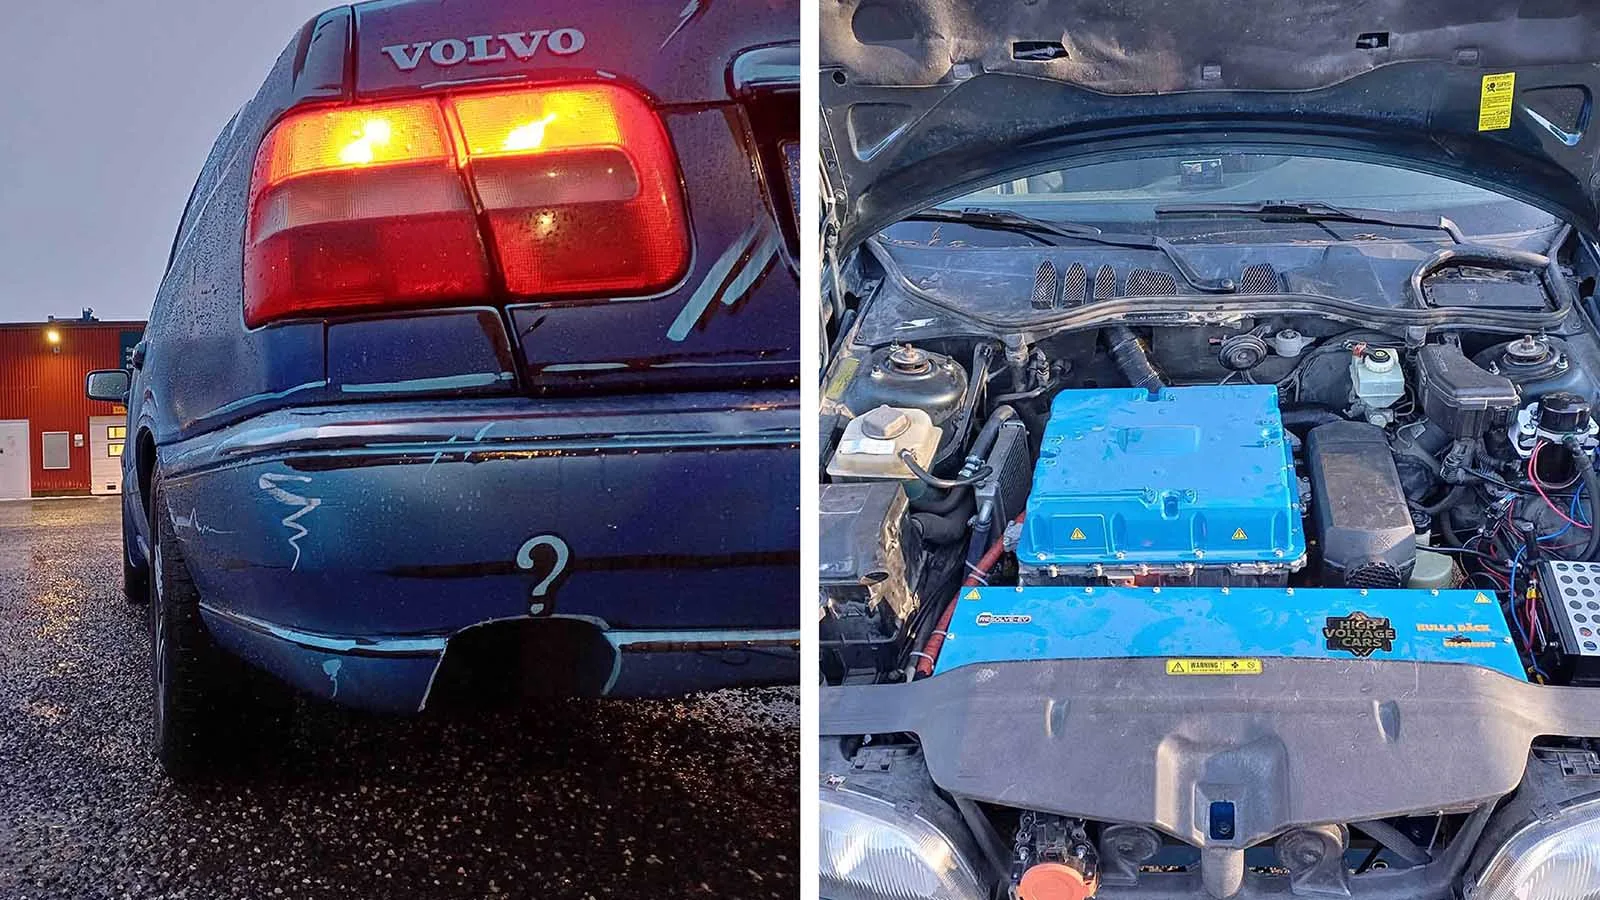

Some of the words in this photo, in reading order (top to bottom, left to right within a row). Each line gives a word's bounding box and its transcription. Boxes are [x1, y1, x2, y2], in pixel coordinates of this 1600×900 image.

[381, 27, 586, 71] VOLVO
[516, 534, 569, 615] ?
[1340, 620, 1377, 630] HIGH
[1324, 628, 1395, 639] VOLTAGE
[1342, 638, 1382, 647] CARS
